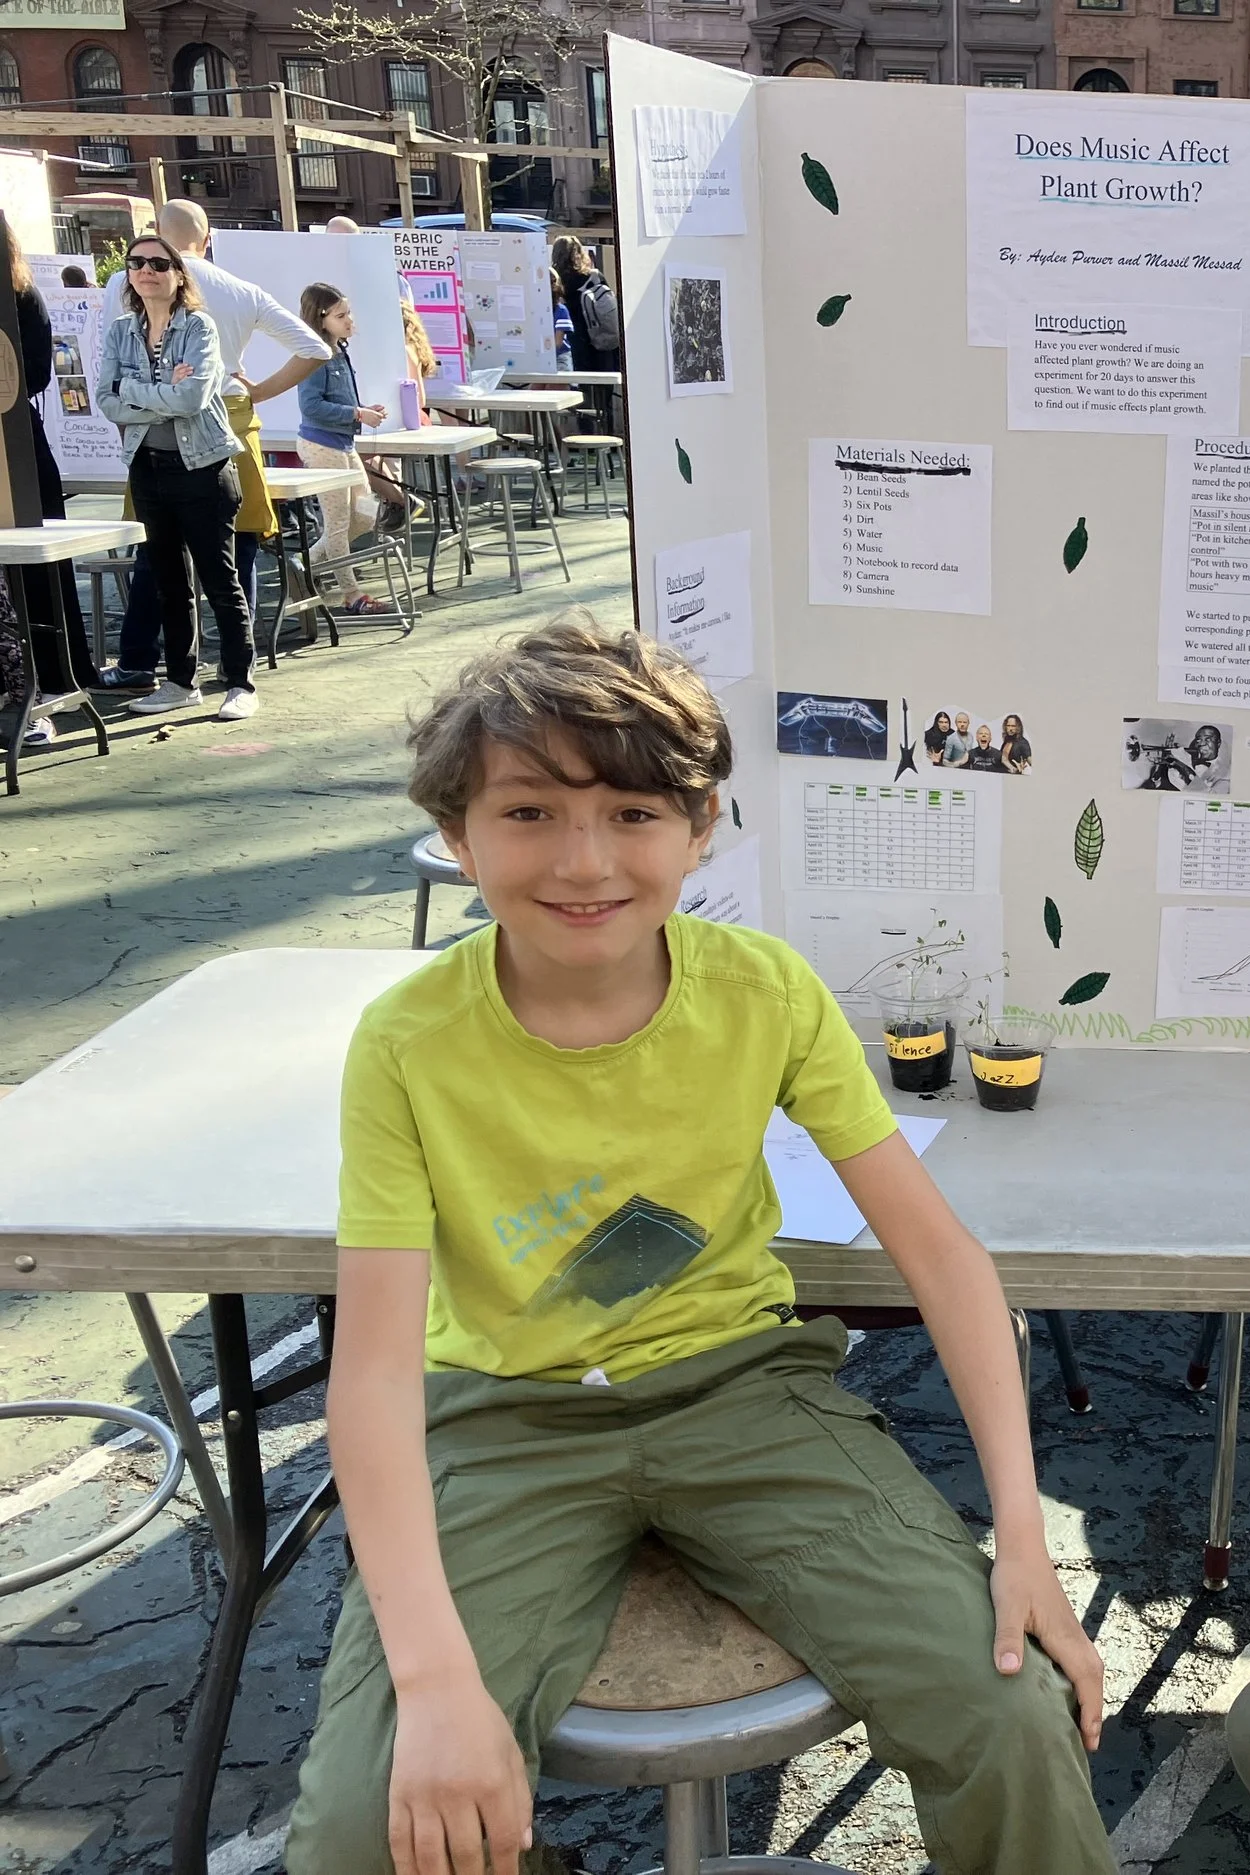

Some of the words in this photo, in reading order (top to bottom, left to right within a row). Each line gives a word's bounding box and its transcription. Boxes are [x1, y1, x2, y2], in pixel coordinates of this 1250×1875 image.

[1016, 134, 1072, 157] Does
[1081, 137, 1150, 160] Music
[1158, 140, 1229, 164] Affect
[1042, 175, 1097, 198] Plant
[1105, 178, 1202, 203] Growth?
[394, 233, 442, 244] FABRIC
[394, 246, 410, 256] BS
[414, 247, 439, 256] THE
[999, 247, 1022, 265] By:
[1026, 249, 1067, 266] Ayden
[1072, 250, 1113, 265] Purver
[1117, 254, 1142, 266] and
[1144, 253, 1190, 268] Massil
[1192, 255, 1242, 270] Messad
[1035, 314, 1125, 330] Introduction
[1035, 339, 1058, 350] Have
[1060, 343, 1077, 352] you
[1100, 343, 1143, 353] wondered
[1145, 344, 1153, 353] if
[1154, 346, 1180, 354] music
[1034, 355, 1070, 365] affected
[1071, 356, 1093, 367] plant
[1096, 358, 1132, 369] growth?
[1133, 358, 1149, 368] We
[1151, 361, 1164, 369] are
[1166, 360, 1191, 371] doing
[1034, 372, 1083, 382] experiment
[1086, 372, 1099, 381] for
[1100, 372, 1112, 381] 20
[1113, 373, 1134, 384] days
[1135, 374, 1145, 383] to
[1147, 376, 1178, 384] answer
[1180, 375, 1196, 384] this
[1034, 386, 1074, 395] question.
[1076, 386, 1092, 395] We
[1094, 388, 1115, 396] want
[1117, 388, 1126, 396] to
[1128, 387, 1139, 397] do
[1141, 388, 1157, 398] this
[1159, 389, 1207, 401] experiment
[1034, 400, 1044, 408] to
[1046, 399, 1063, 409] find
[1082, 401, 1090, 410] if
[1091, 402, 1117, 411] music
[1118, 402, 1148, 412] effects
[1150, 403, 1172, 414] plant
[1173, 405, 1206, 415] growth.
[837, 445, 905, 463] Materials
[911, 450, 969, 467] Needed:
[1193, 463, 1208, 472] We
[1210, 464, 1242, 474] planted
[856, 473, 879, 482] Bean
[881, 474, 906, 484] Seeds
[1192, 478, 1220, 487] named
[1222, 478, 1236, 488] the
[843, 485, 852, 496] 2)
[856, 486, 882, 496] Lentil
[884, 488, 909, 498] Seeds
[1191, 493, 1213, 501] areas
[1215, 492, 1232, 502] like
[843, 499, 852, 510] 3)
[856, 500, 871, 510] Six
[873, 501, 892, 511] Pots
[843, 514, 852, 524] 4)
[857, 514, 874, 524] Dirt
[843, 528, 852, 538] 5)
[856, 529, 882, 539] Water
[1223, 523, 1247, 533] silent
[842, 542, 852, 552] 6)
[856, 542, 882, 553] Music
[843, 556, 852, 566] 7)
[856, 556, 898, 568] Notebook
[900, 561, 909, 569] to
[911, 562, 938, 571] record
[940, 563, 958, 572] data
[1211, 559, 1230, 568] with
[1232, 561, 1248, 569] two
[843, 570, 852, 580] 8)
[856, 570, 889, 581] Camera
[1189, 570, 1213, 579] hours
[1215, 571, 1240, 582] heavy
[843, 583, 852, 593] 9)
[856, 584, 895, 596] Sunshine
[667, 597, 705, 619] Information
